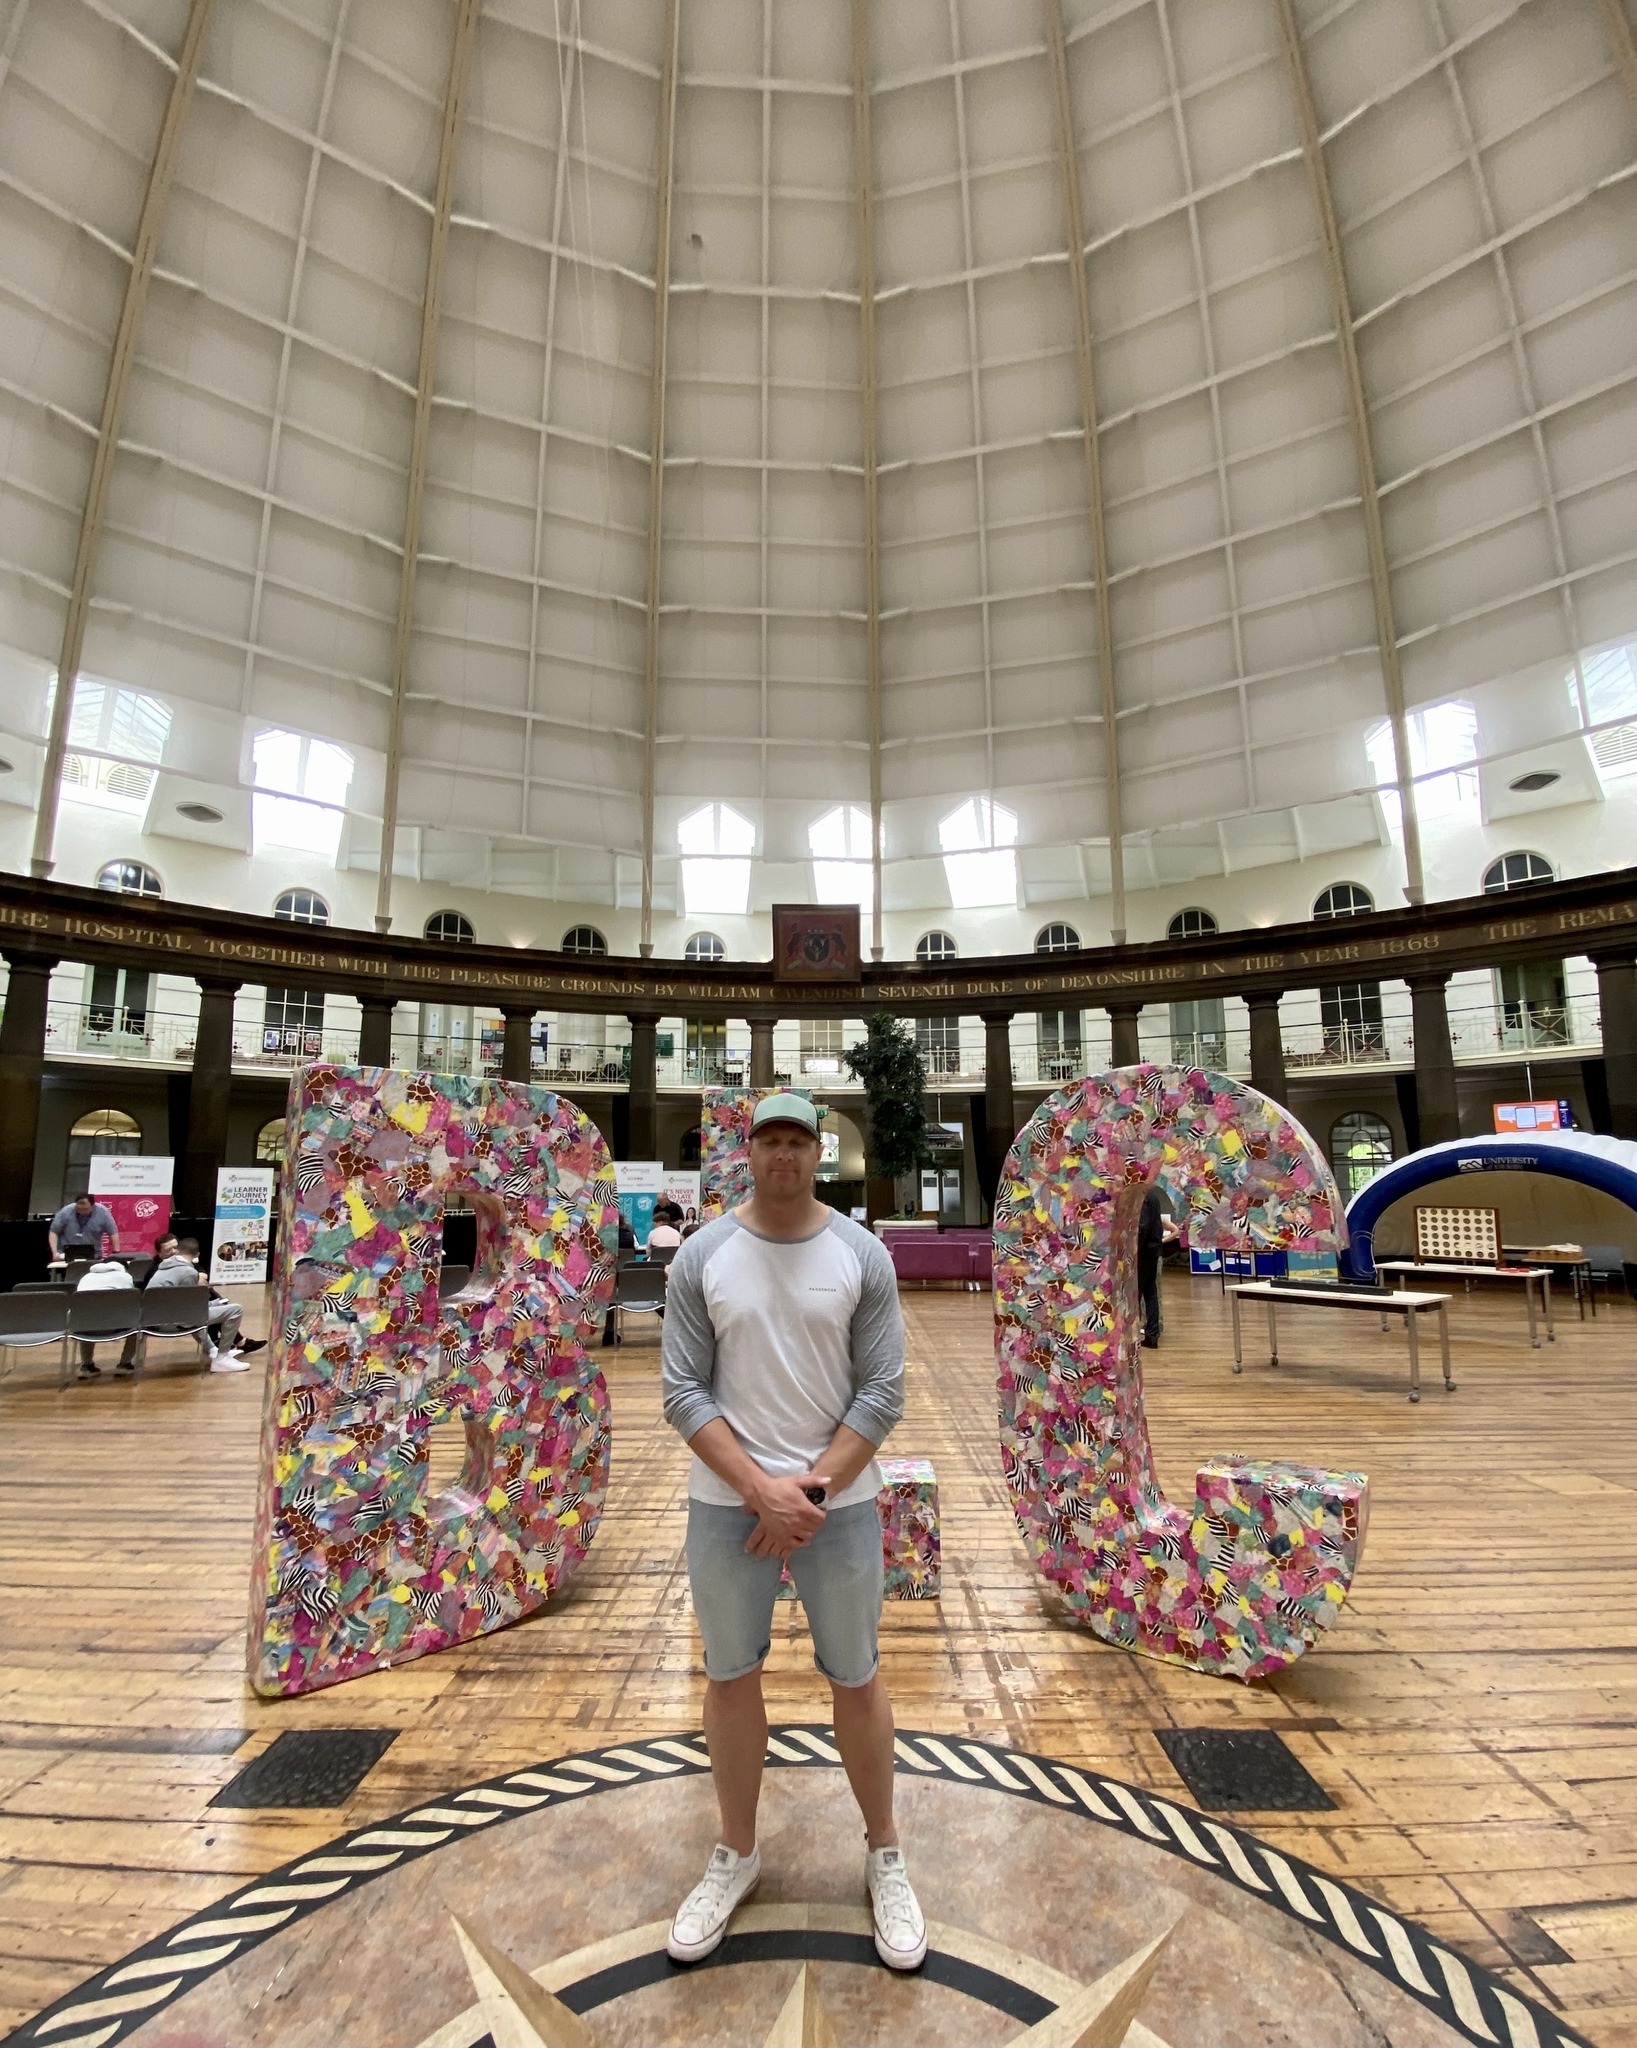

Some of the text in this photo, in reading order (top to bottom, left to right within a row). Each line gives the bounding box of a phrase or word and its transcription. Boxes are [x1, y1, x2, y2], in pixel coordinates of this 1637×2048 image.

[64, 917, 192, 950] HOSPITAL
[204, 938, 326, 968] TOGETHER
[337, 957, 388, 975] WITH
[402, 964, 440, 980] THE
[449, 969, 551, 989] PLEASURE
[560, 978, 645, 995] GROUNDS
[655, 983, 677, 996] BY
[688, 985, 760, 998] WILLIAM
[878, 984, 955, 998] SEVENTH
[966, 980, 1013, 996] DUKE
[1024, 978, 1048, 991] OF
[1061, 965, 1185, 989] DEVONSHIRE
[1201, 963, 1226, 976] IN
[1240, 955, 1284, 971] THE
[1299, 945, 1360, 965] YEAR
[1378, 934, 1440, 955] 1868
[1482, 918, 1537, 941] THE
[1483, 1157, 1539, 1165] UNIVERSITY
